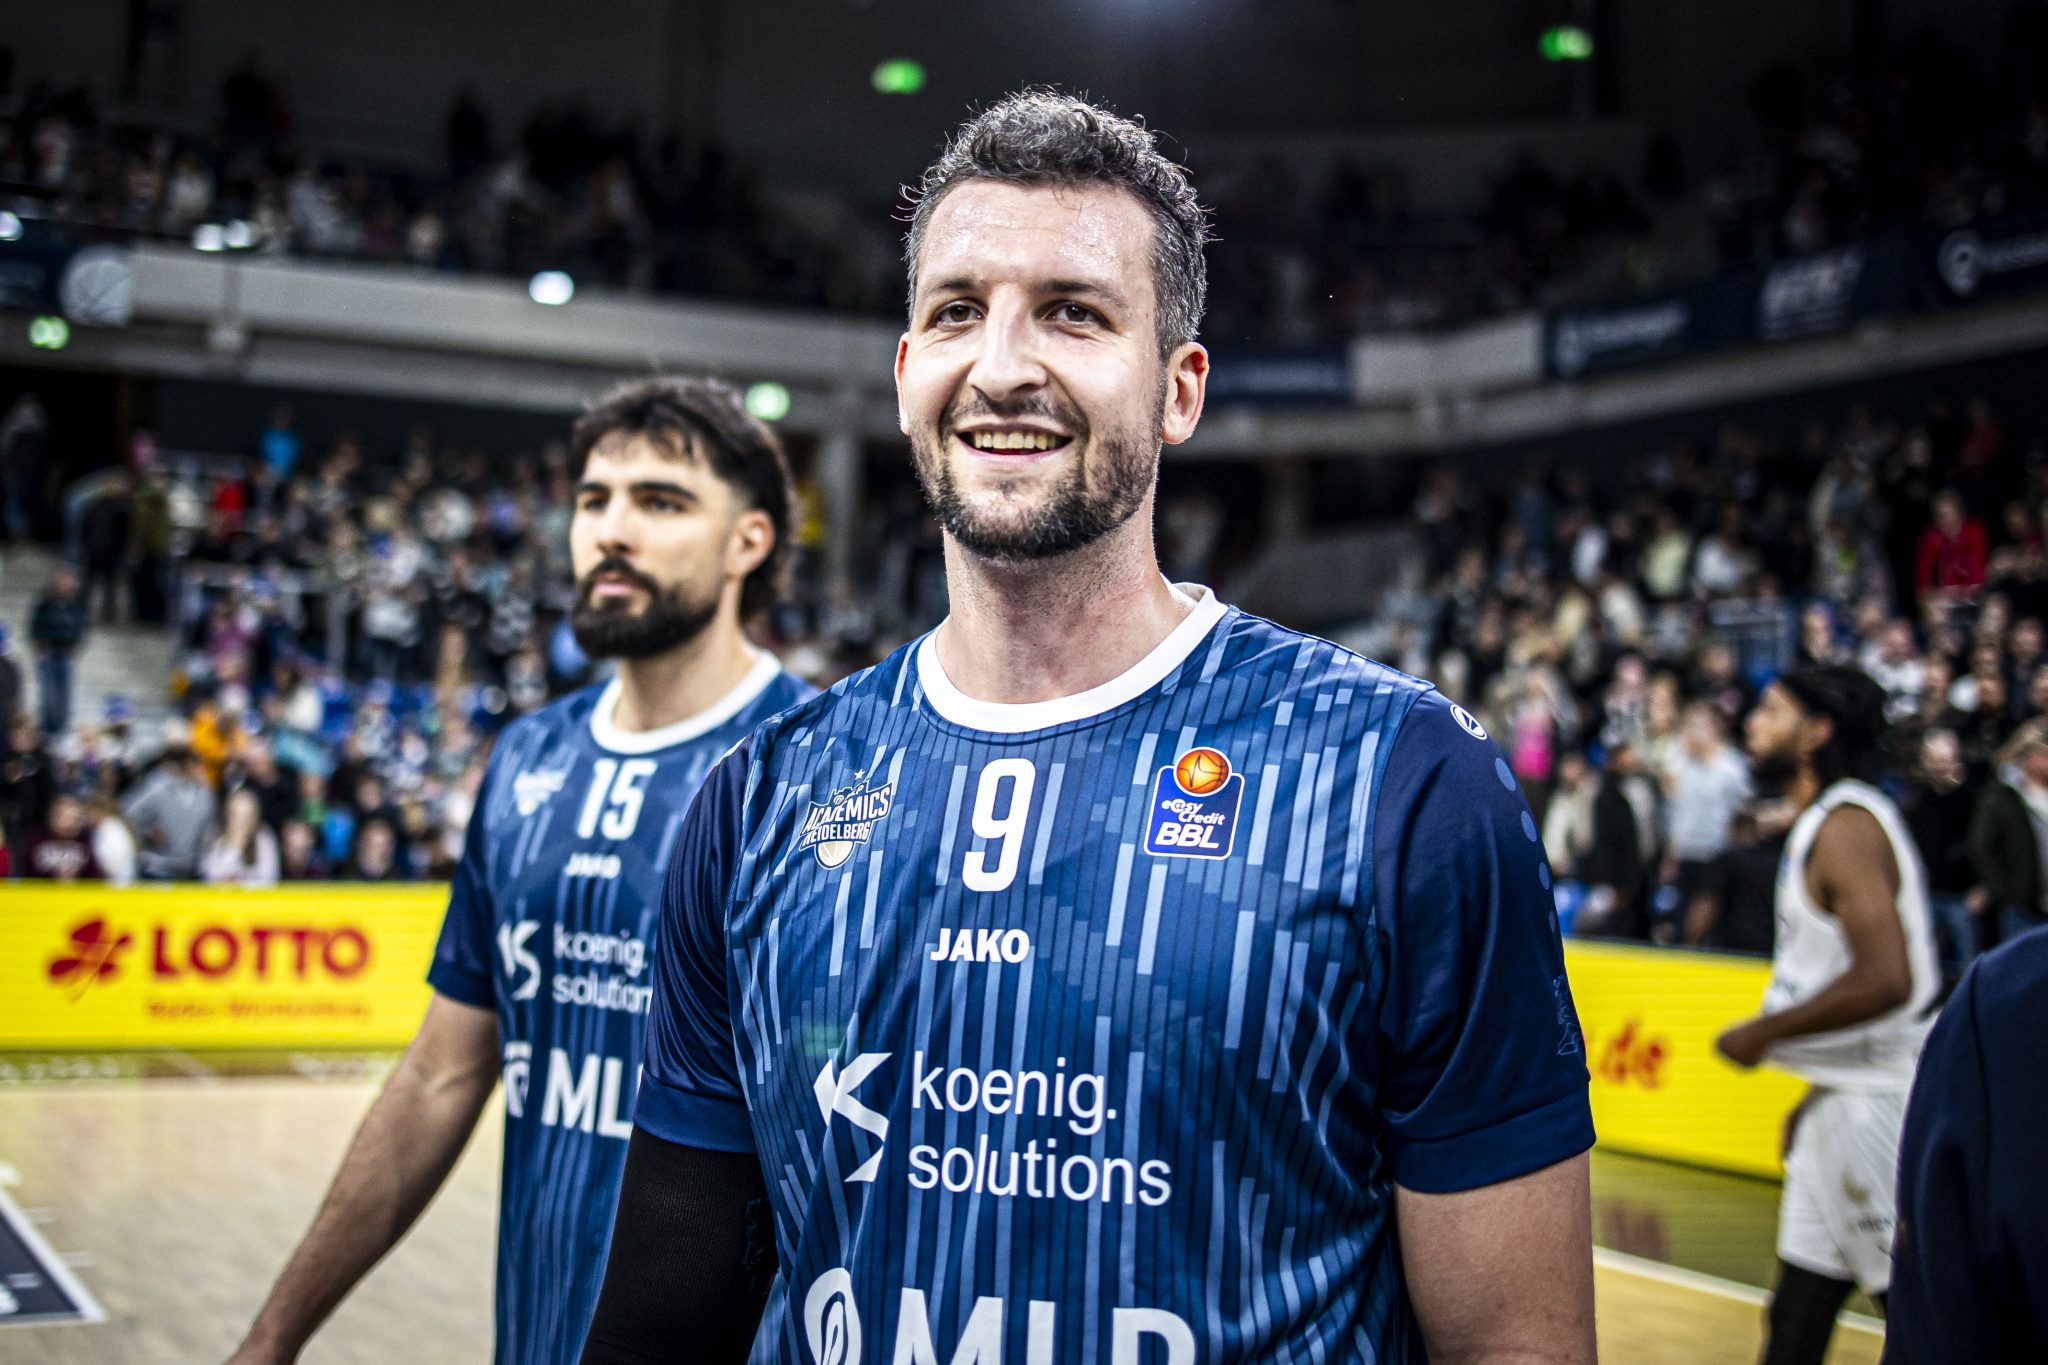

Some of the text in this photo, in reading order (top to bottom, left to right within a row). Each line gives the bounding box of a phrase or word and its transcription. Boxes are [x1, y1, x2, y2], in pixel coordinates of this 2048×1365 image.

[577, 758, 658, 840] 15
[962, 758, 1036, 892] 9
[1154, 821, 1219, 849] BBL
[151, 923, 372, 983] LOTTO
[930, 928, 1031, 963] JAKO
[552, 970, 653, 1015] solution
[541, 1046, 644, 1140] ML
[911, 1050, 1117, 1136] koenig.
[908, 1133, 1172, 1207] solutions
